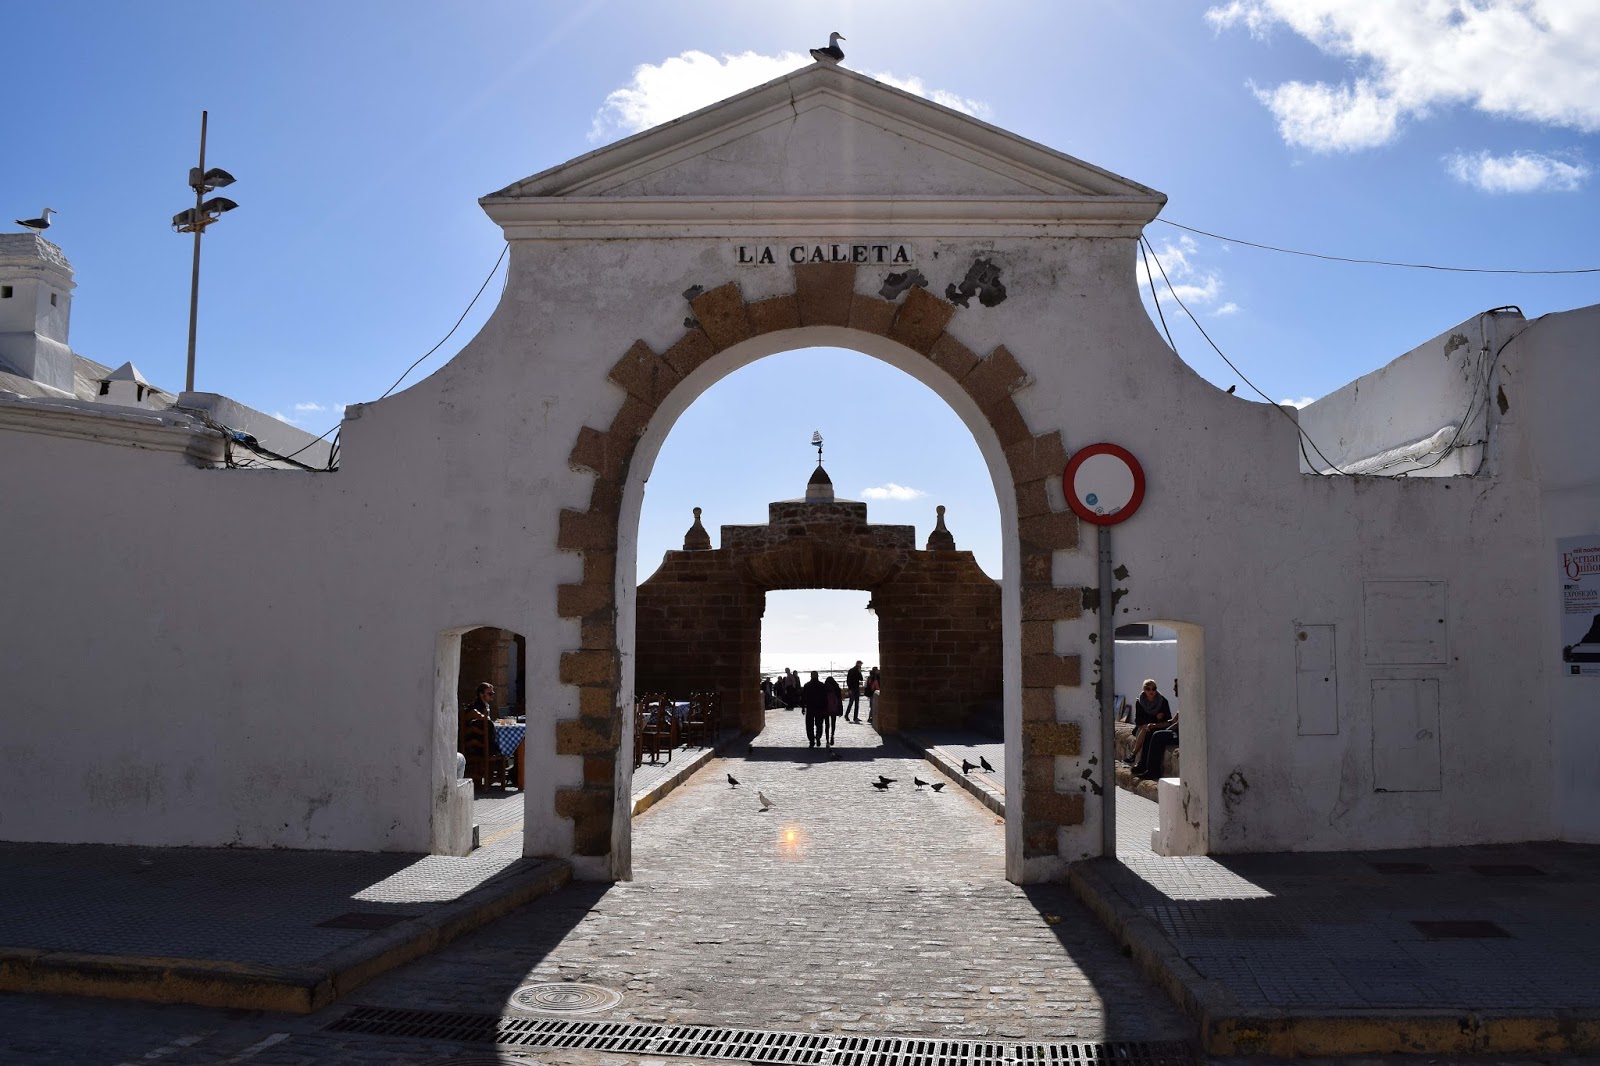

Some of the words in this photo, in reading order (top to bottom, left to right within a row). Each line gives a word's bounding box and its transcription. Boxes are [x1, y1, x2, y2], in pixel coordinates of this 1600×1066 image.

[738, 246, 775, 264] LA
[790, 244, 909, 264] CALETA
[1566, 561, 1600, 581] Quiño
[1564, 589, 1598, 598] EXPOSICIÓN
